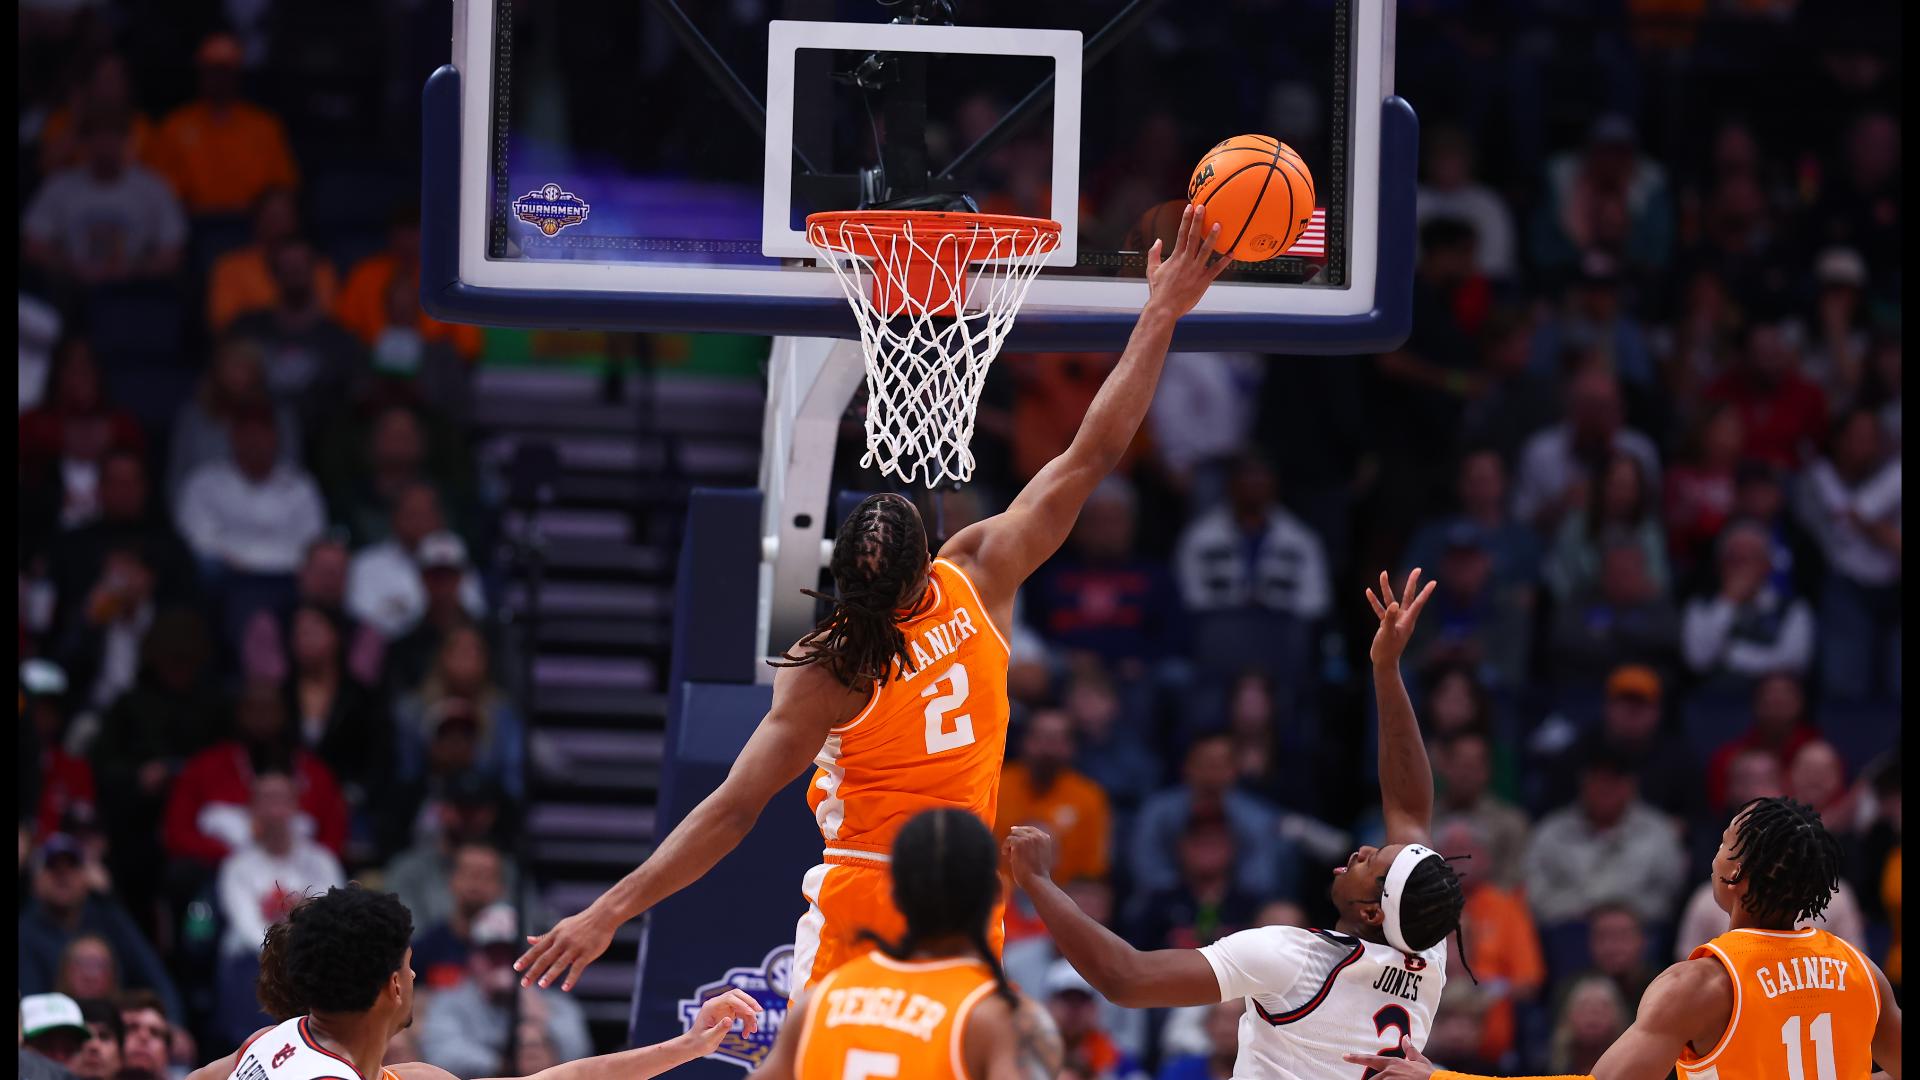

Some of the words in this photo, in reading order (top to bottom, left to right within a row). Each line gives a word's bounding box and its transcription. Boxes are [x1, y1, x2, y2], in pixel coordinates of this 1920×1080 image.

[545, 186, 559, 200] SEC
[1188, 163, 1215, 200] CAA
[515, 204, 588, 218] TOURNAMENT
[920, 661, 976, 755] 2
[1373, 965, 1423, 1002] JONES
[1756, 956, 1848, 999] GAINEY
[1781, 1012, 1838, 1080] 11
